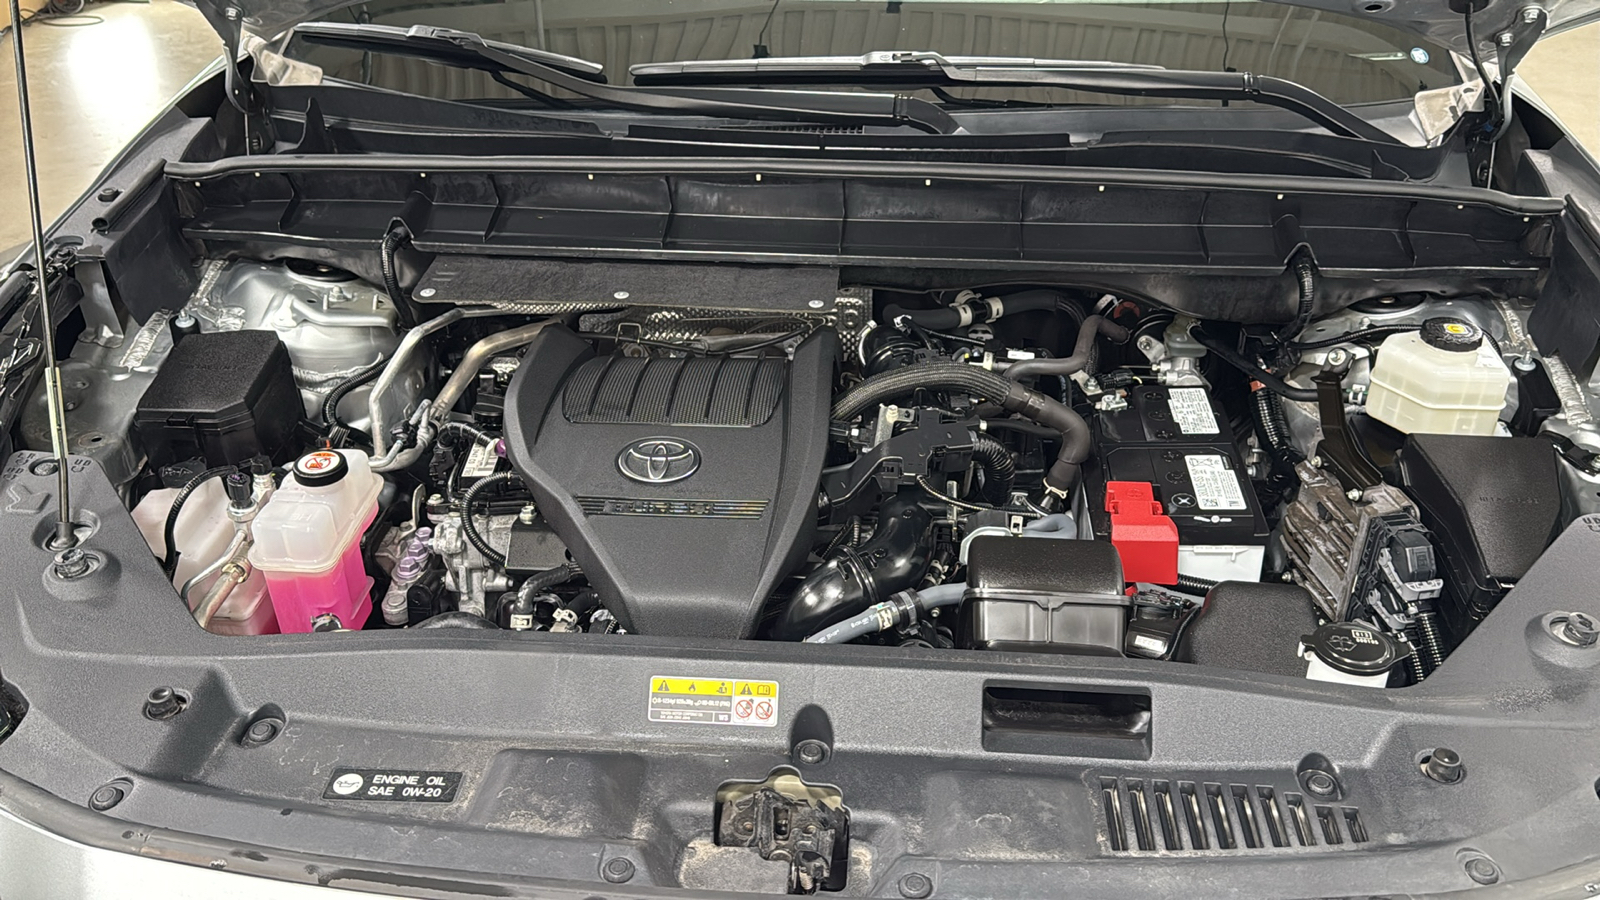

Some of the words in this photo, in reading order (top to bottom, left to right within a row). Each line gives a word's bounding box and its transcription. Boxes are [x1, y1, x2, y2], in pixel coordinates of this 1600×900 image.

[372, 774, 419, 785] ENGINE
[426, 776, 446, 786] OIL
[367, 787, 396, 796] SAE
[402, 787, 442, 797] 0W-20
